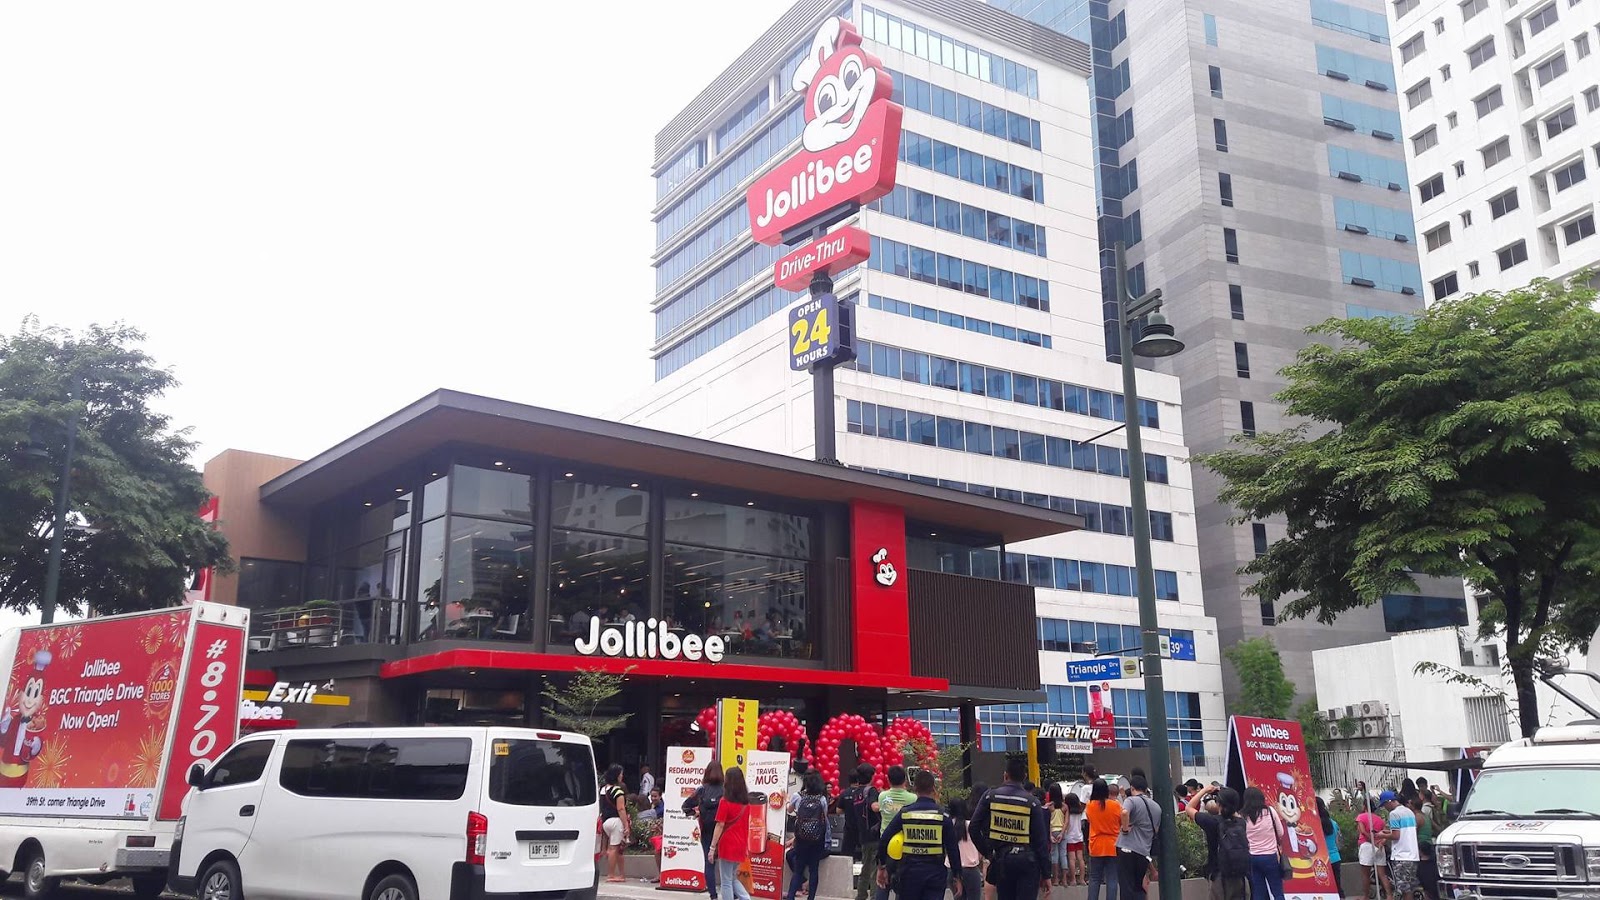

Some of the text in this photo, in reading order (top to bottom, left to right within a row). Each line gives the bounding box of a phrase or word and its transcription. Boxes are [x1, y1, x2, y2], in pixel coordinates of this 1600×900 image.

[757, 143, 873, 227] Jollibee
[780, 234, 846, 281] Drive-Thru
[797, 300, 822, 317] OPEN
[791, 308, 832, 355] 24
[796, 345, 829, 368] HOURS
[574, 615, 725, 662] Jollibee
[81, 659, 121, 678] Jollibee
[1069, 663, 1107, 675] Triangle
[49, 682, 145, 706] BGC Triangle Drive
[151, 680, 174, 693] 1000
[267, 681, 318, 704] Exit
[150, 691, 171, 701] STORES
[60, 710, 121, 732] Now Open!
[734, 700, 746, 751] Thru
[1038, 722, 1101, 740] Drive-Thru
[1251, 723, 1290, 740] Jollibee
[1246, 740, 1300, 752] BGC TRIANGLE DRIVE
[1255, 751, 1296, 765] Now Open!
[668, 766, 705, 776] REDEMPTIO
[756, 767, 778, 775] TRAVEL
[755, 774, 779, 785] MUG
[26, 796, 106, 810] 39th St. corner Triangle Drive
[993, 816, 1026, 831] MARSHAL
[906, 827, 938, 842] MARSHAL
[750, 856, 761, 865] only
[665, 876, 691, 887] Jollibee
